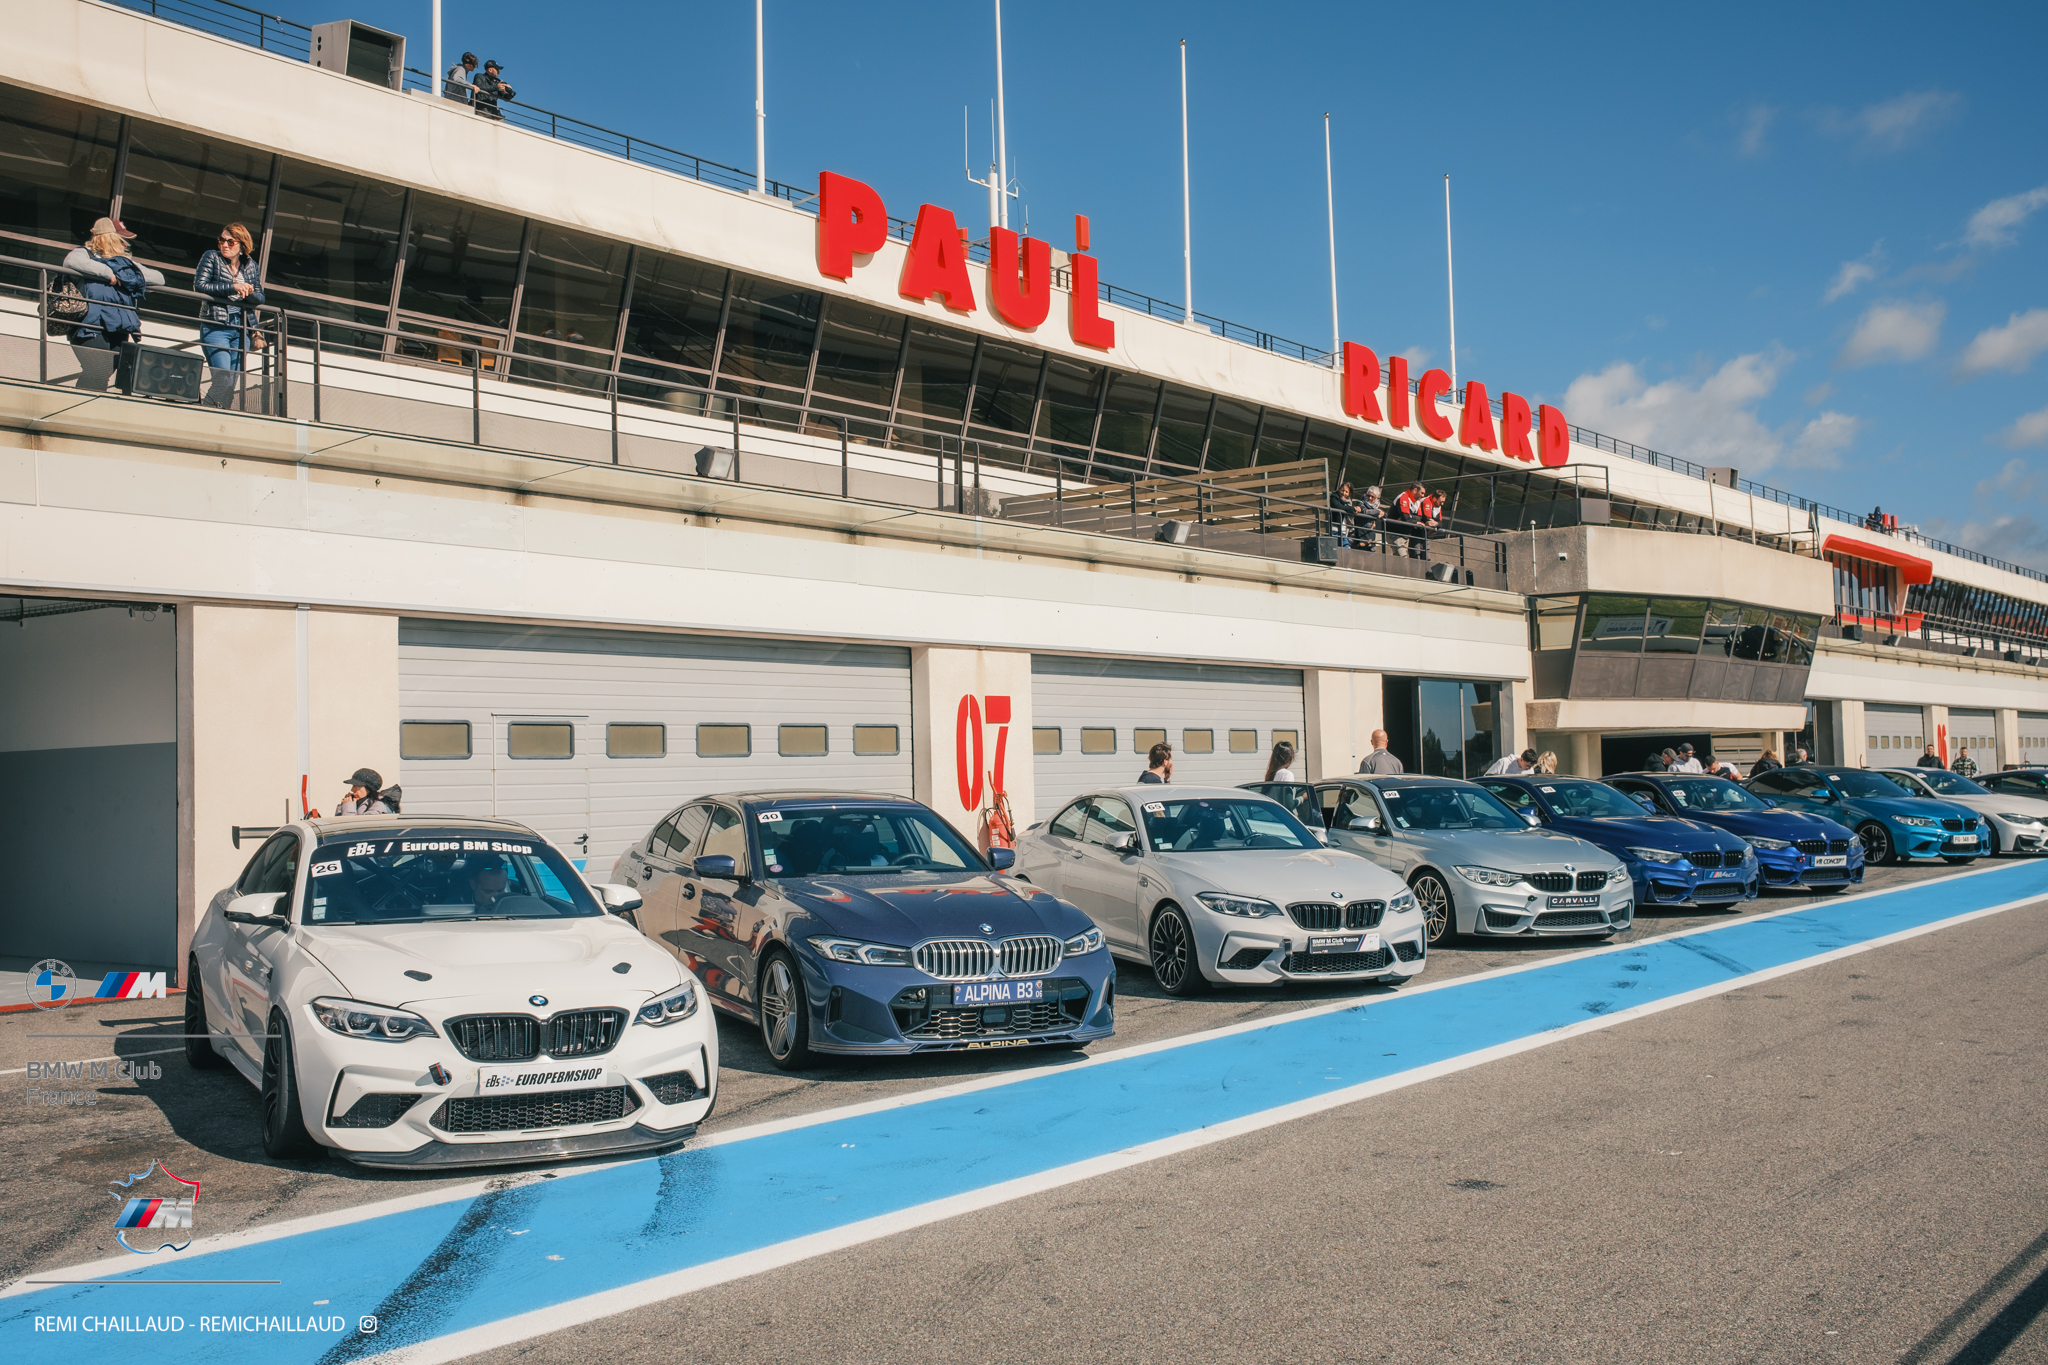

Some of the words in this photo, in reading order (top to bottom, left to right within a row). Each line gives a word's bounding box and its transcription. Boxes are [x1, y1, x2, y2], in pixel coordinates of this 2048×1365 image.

[819, 170, 1115, 350] PAUL
[1343, 341, 1569, 469] RICARD
[956, 694, 1011, 811] 07
[401, 840, 460, 852] Europe
[463, 839, 489, 851] BM
[491, 841, 532, 855] Shop
[315, 862, 338, 874] 26
[1551, 896, 1598, 904] CARVALLI
[964, 983, 1011, 1002] ALPINA
[1017, 981, 1034, 999] B3
[967, 1039, 1029, 1049] ALPINA
[515, 1068, 603, 1086] EUROPEBMSHOP
